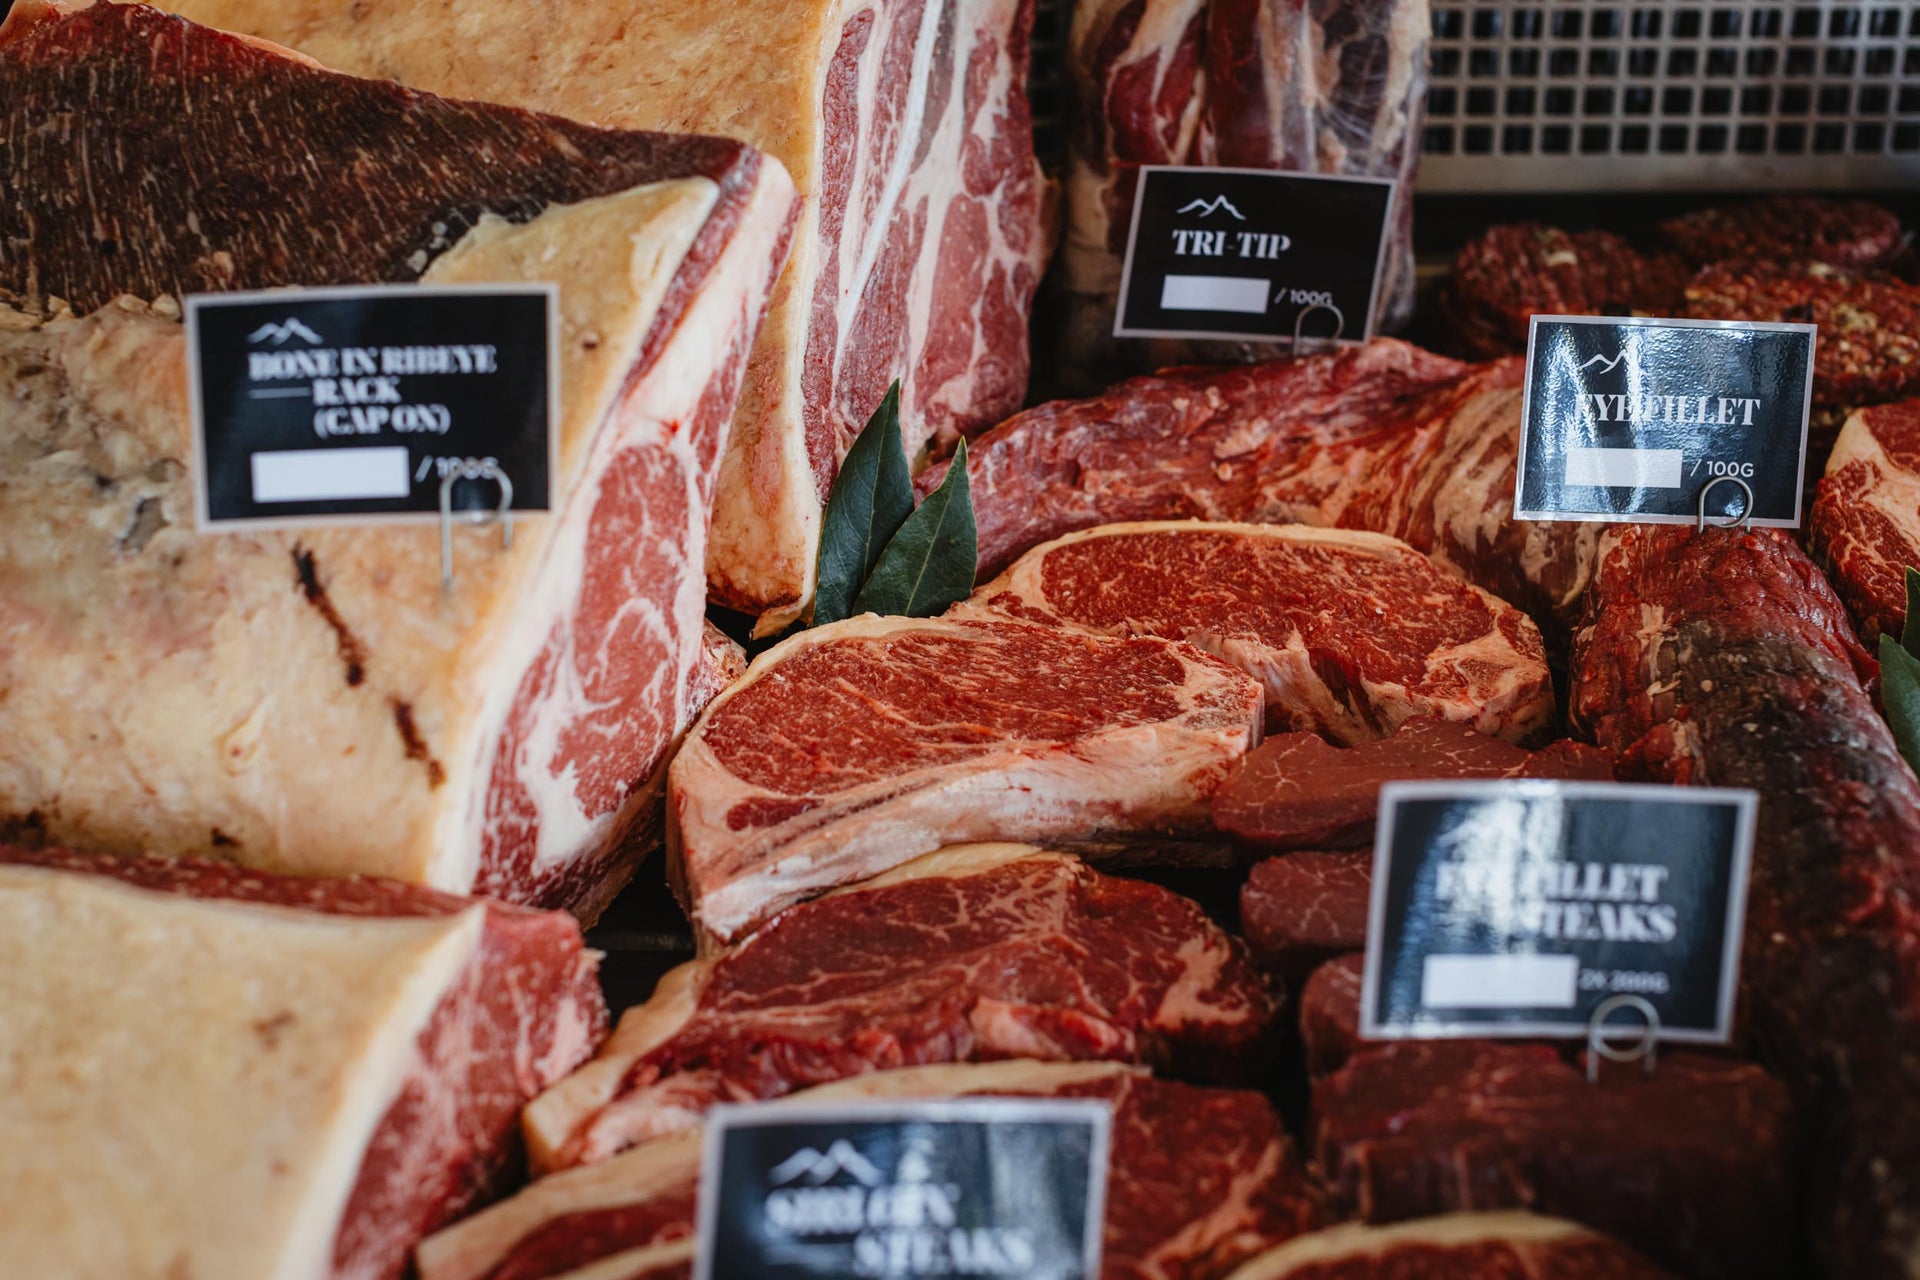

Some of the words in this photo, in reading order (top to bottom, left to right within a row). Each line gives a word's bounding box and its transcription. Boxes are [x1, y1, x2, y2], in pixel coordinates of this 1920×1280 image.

[1172, 229, 1292, 260] TRI-TIP
[248, 350, 340, 382] BONE
[341, 346, 378, 377] IN
[381, 344, 498, 375] RIBEYE
[312, 376, 402, 406] RACK
[313, 404, 390, 440] (CAP
[391, 403, 452, 437] ON)
[1640, 394, 1761, 426] FILLET
